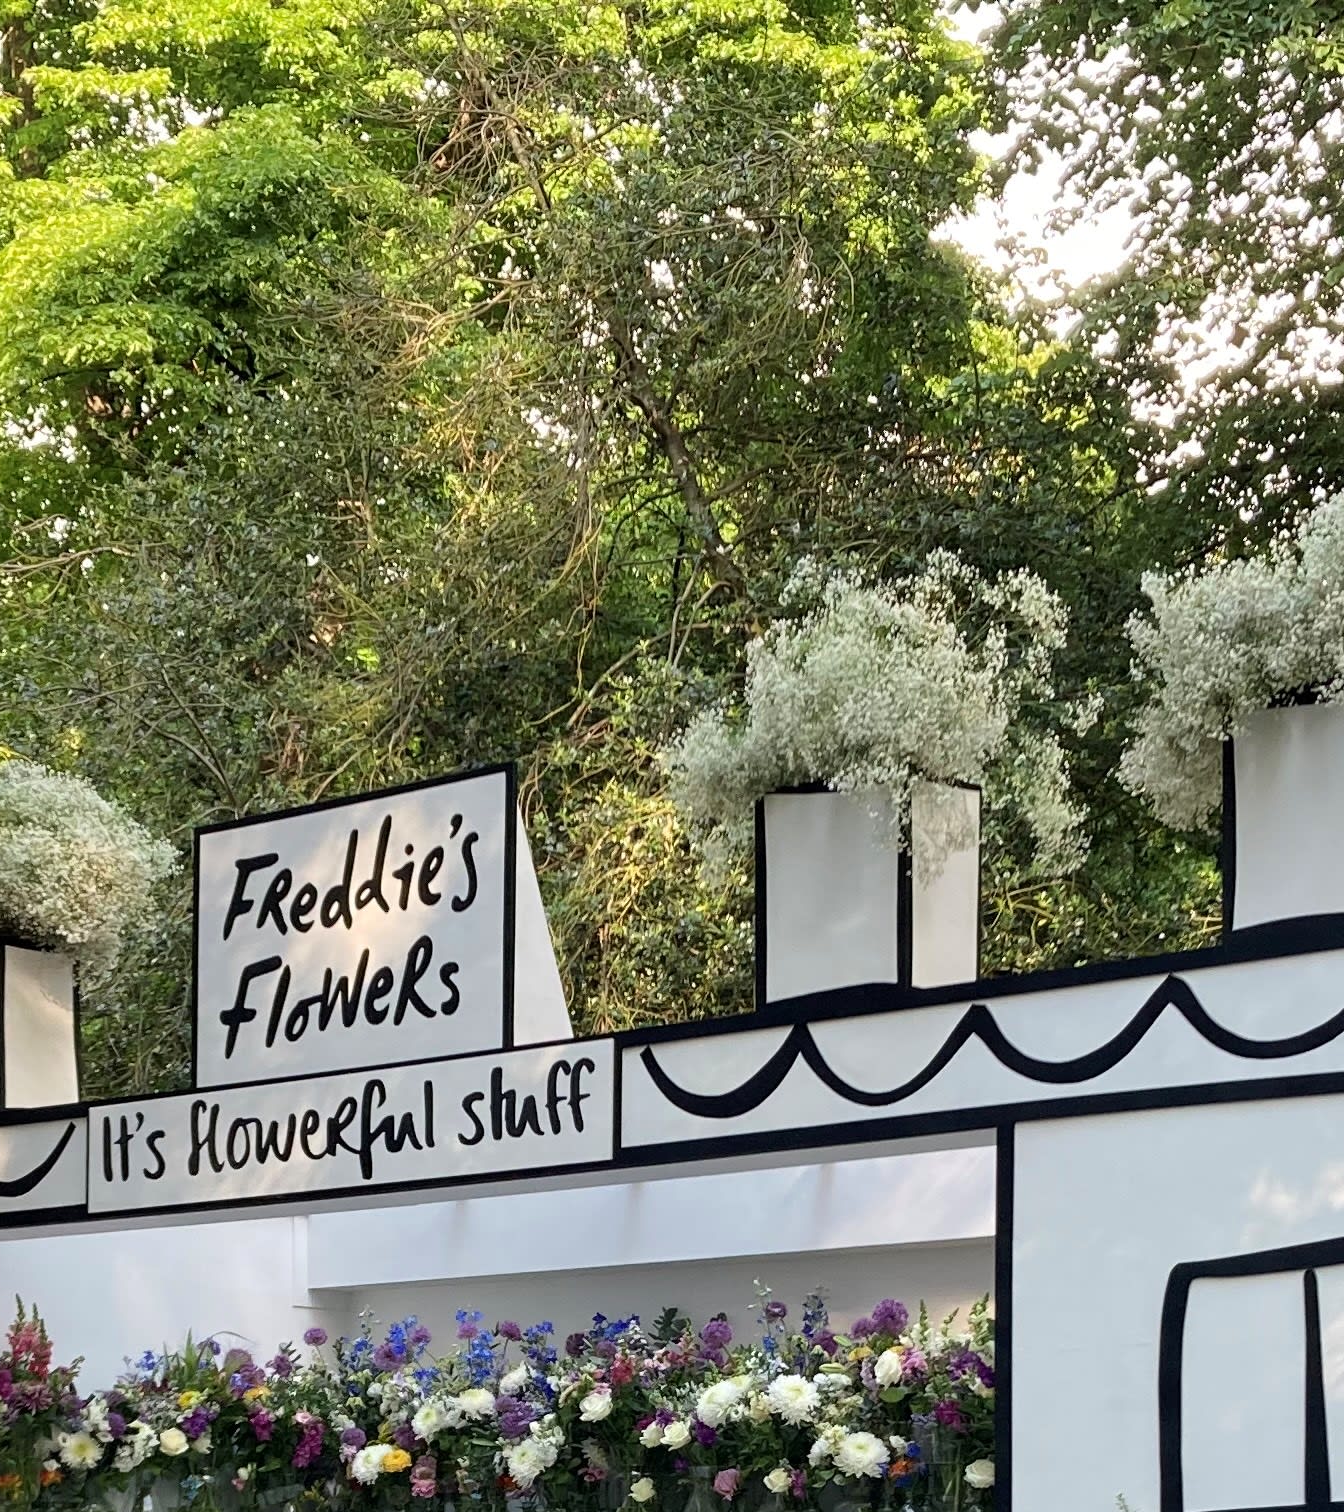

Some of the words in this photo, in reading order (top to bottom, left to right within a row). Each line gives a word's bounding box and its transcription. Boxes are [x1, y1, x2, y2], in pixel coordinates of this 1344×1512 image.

[223, 813, 479, 941] Freddie's
[220, 935, 459, 1060] Flowers
[103, 1111, 166, 1182] It's
[187, 1079, 434, 1180] flowerful
[457, 1057, 594, 1146] stuff
